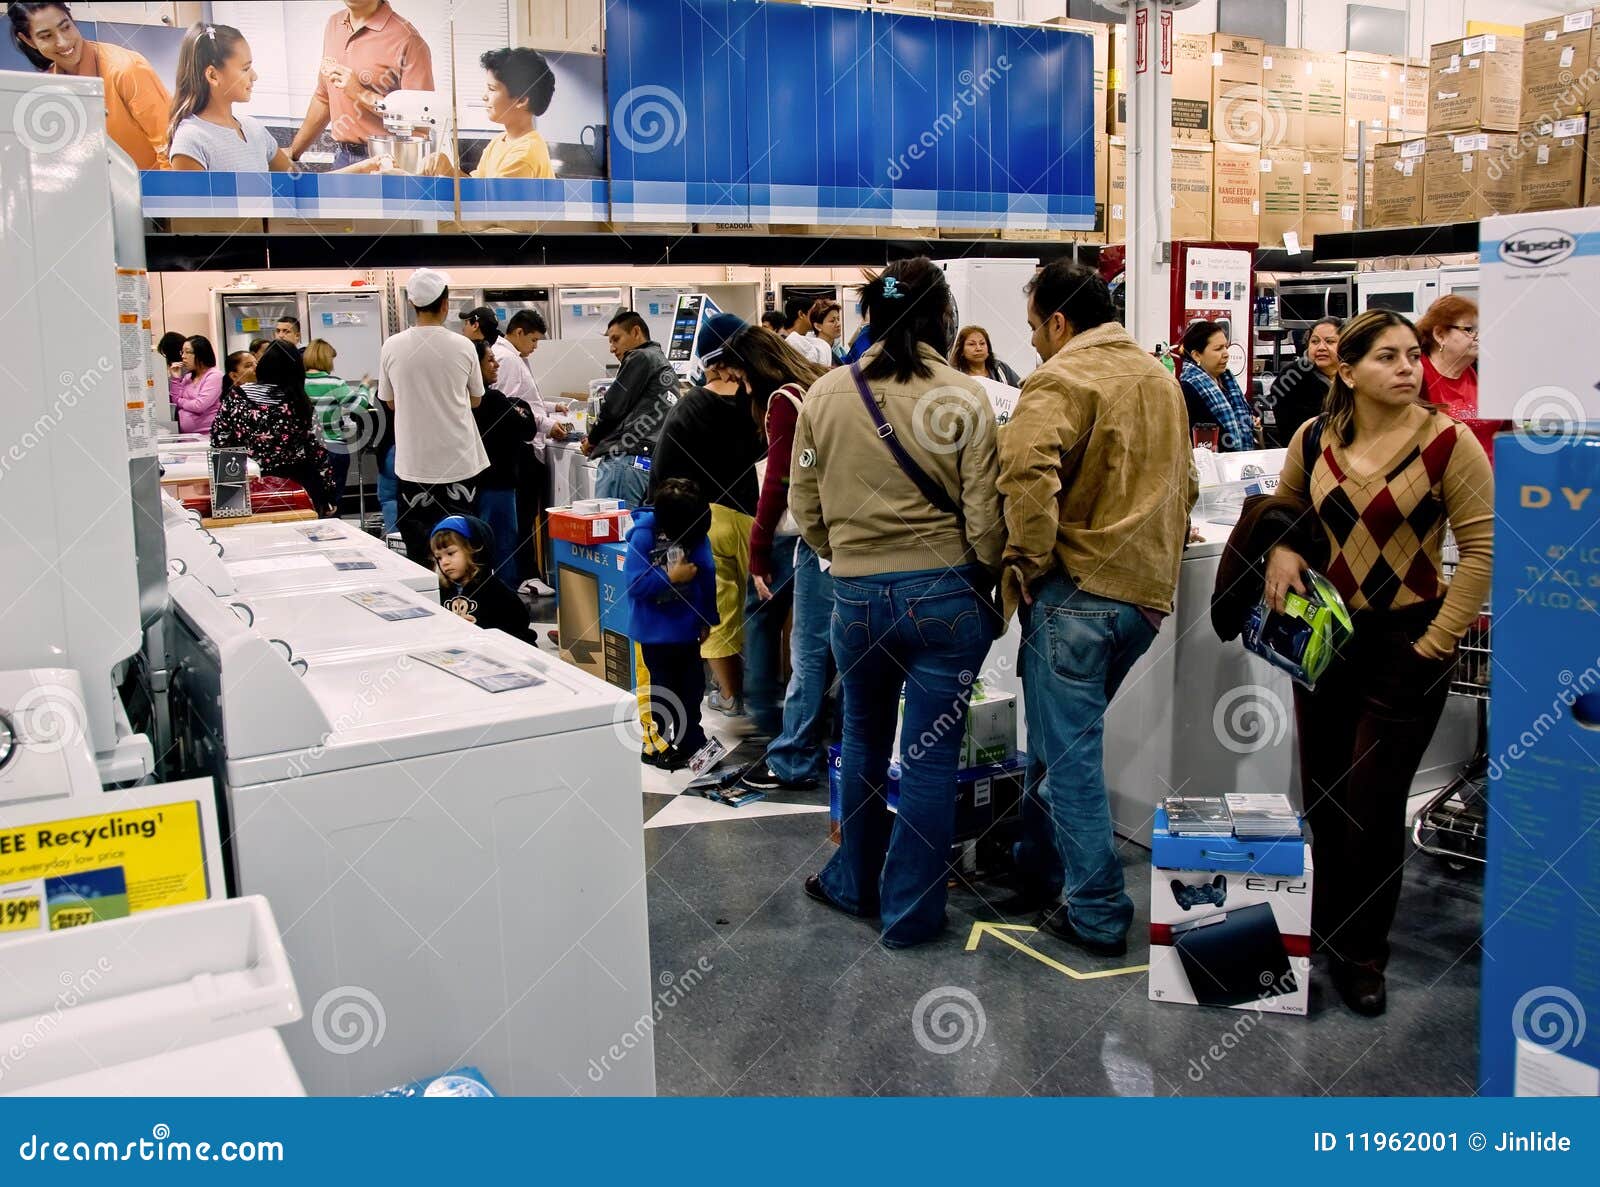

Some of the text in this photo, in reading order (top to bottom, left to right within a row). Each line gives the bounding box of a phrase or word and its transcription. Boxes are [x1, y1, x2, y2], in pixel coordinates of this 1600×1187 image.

[1503, 237, 1572, 255] Klipsch
[1519, 485, 1593, 511] DY
[571, 544, 610, 566] DYNEX
[1516, 588, 1536, 605] TV
[1540, 592, 1571, 609] LCD
[19, 857, 71, 874] everyday
[75, 854, 94, 865] low
[98, 850, 126, 863] price
[1244, 877, 1308, 895] PS3
